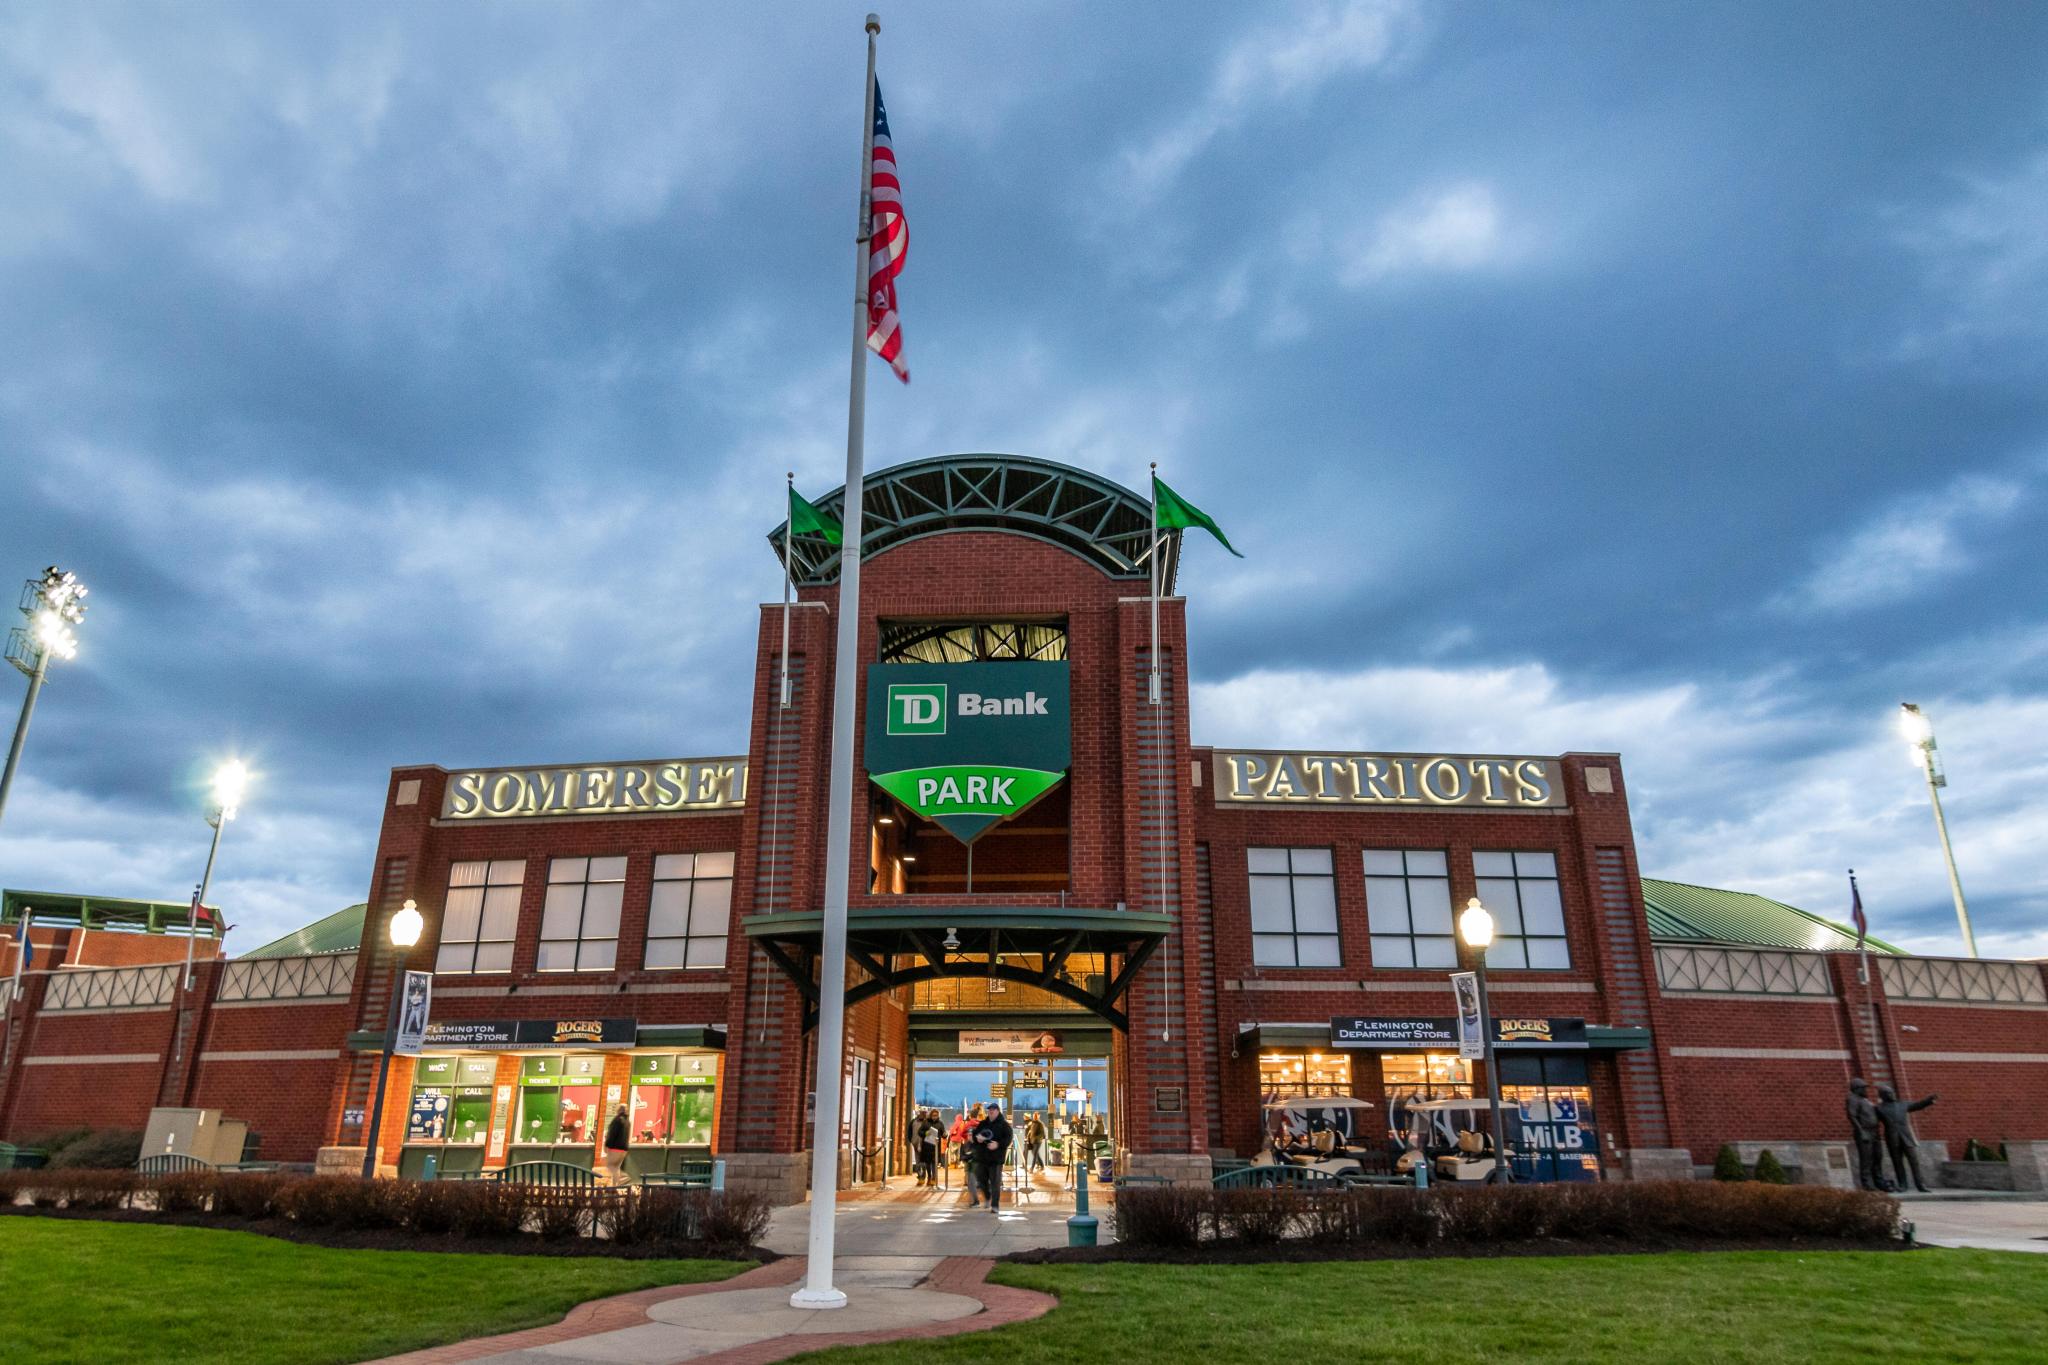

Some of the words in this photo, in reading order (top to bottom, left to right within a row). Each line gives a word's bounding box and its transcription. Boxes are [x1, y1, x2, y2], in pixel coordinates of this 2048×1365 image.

[895, 694, 940, 724] TD
[958, 691, 1049, 716] Bank
[1230, 755, 1551, 802] PATRIOTS
[450, 763, 747, 815] SOMERSET
[918, 776, 1017, 806] PARK
[555, 1020, 603, 1034] ROGER'S
[1500, 1019, 1550, 1033] ROGER'S
[538, 1061, 546, 1072] 1
[580, 1061, 590, 1072] 2
[650, 1060, 658, 1071] 3
[691, 1060, 701, 1071] 4
[1521, 1125, 1584, 1149] MiLB
